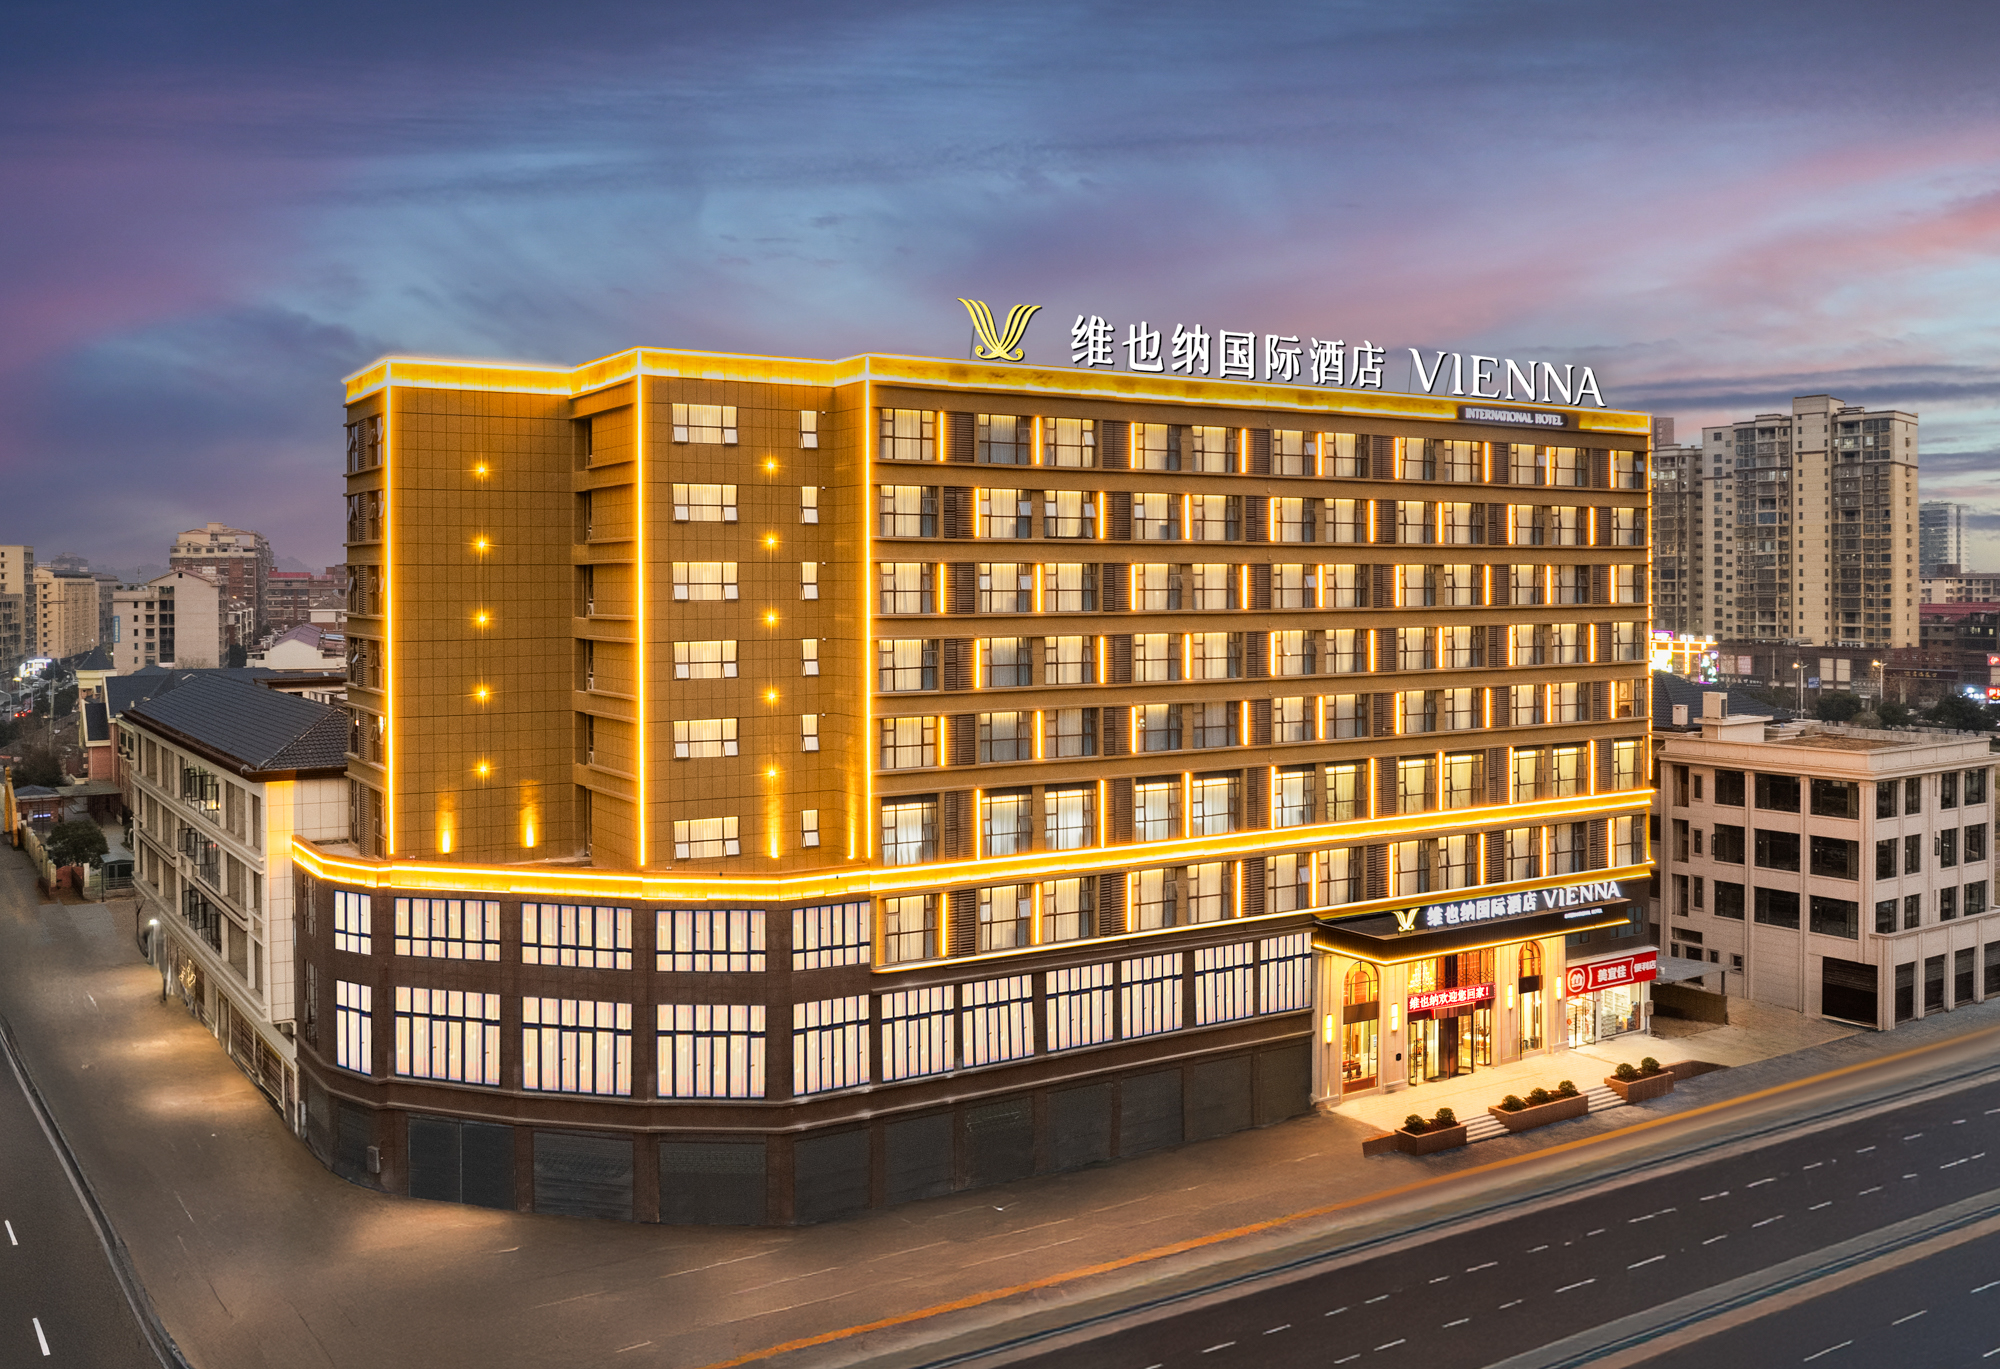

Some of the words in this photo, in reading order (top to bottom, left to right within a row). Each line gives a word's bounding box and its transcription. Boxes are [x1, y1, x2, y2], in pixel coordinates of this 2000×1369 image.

[1070, 313, 1386, 389] 维也纳国际酒店
[1408, 347, 1607, 407] VIENNA
[1465, 407, 1533, 424] INTERNATIONAL
[1534, 413, 1563, 426] HOTEL
[1426, 891, 1538, 927] 维也纳国际酒店
[1541, 881, 1621, 909] VIENNA
[1597, 965, 1627, 983] 美宜佳
[1633, 960, 1656, 973] 便利店
